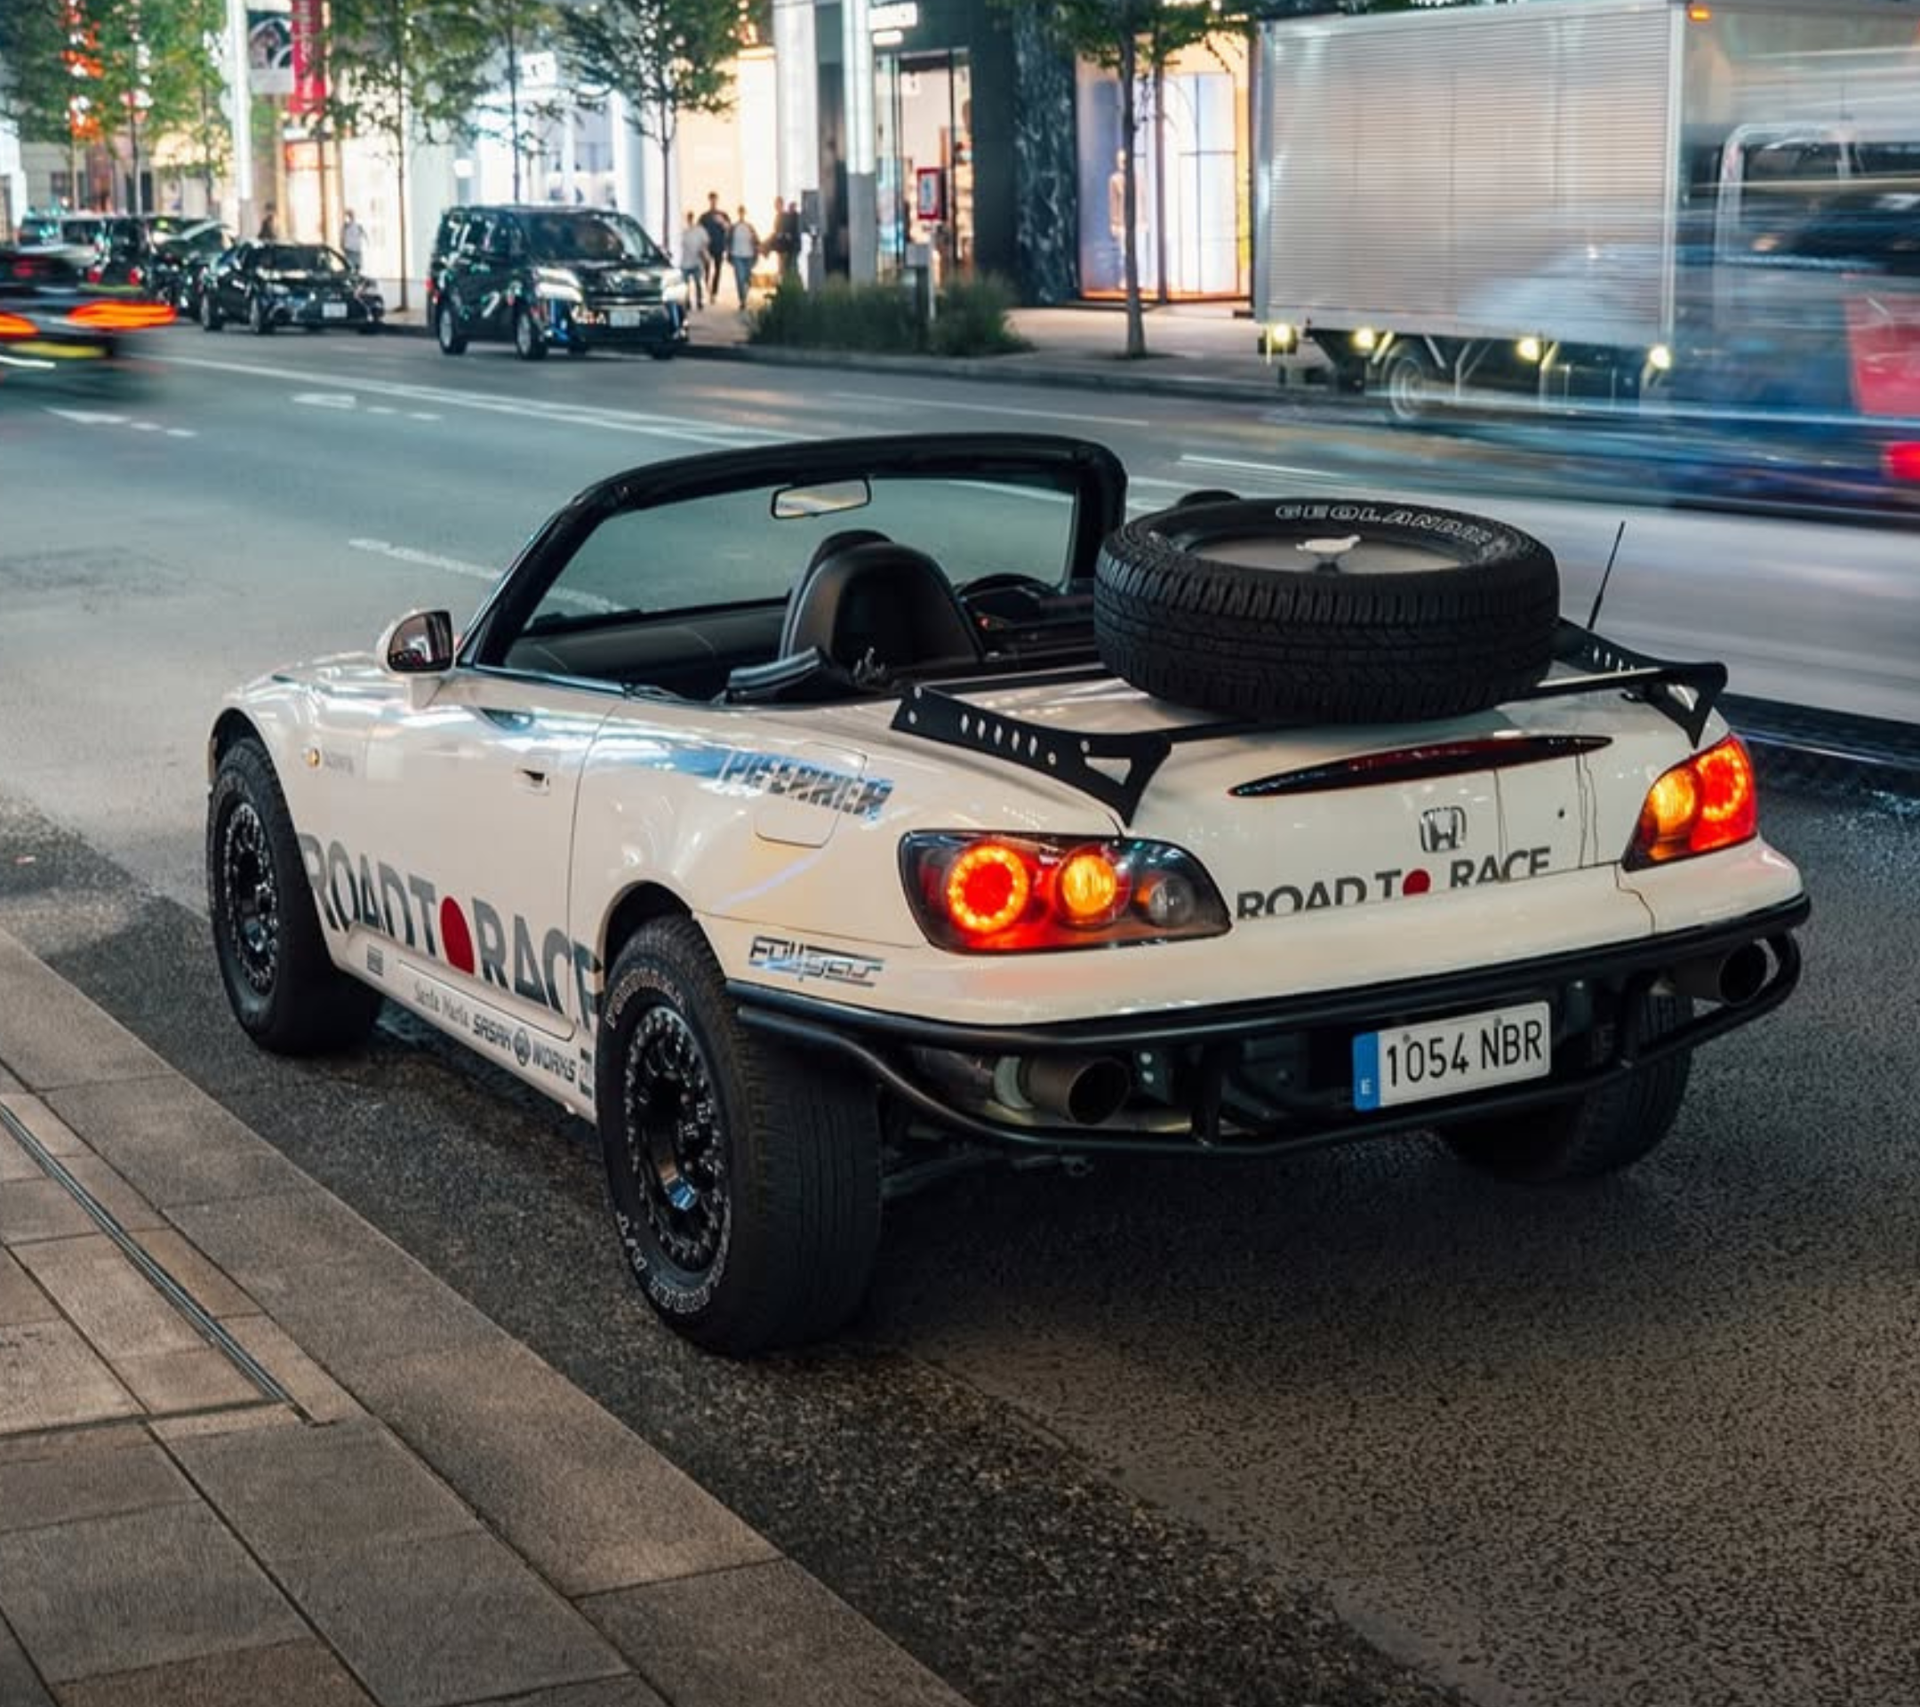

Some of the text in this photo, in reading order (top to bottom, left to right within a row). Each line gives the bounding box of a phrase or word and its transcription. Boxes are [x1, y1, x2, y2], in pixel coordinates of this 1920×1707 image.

[1237, 876, 1367, 919] ROAD
[1450, 846, 1551, 888] RACE
[1360, 1078, 1371, 1096] E
[1386, 1020, 1542, 1087] 1054 NBR
